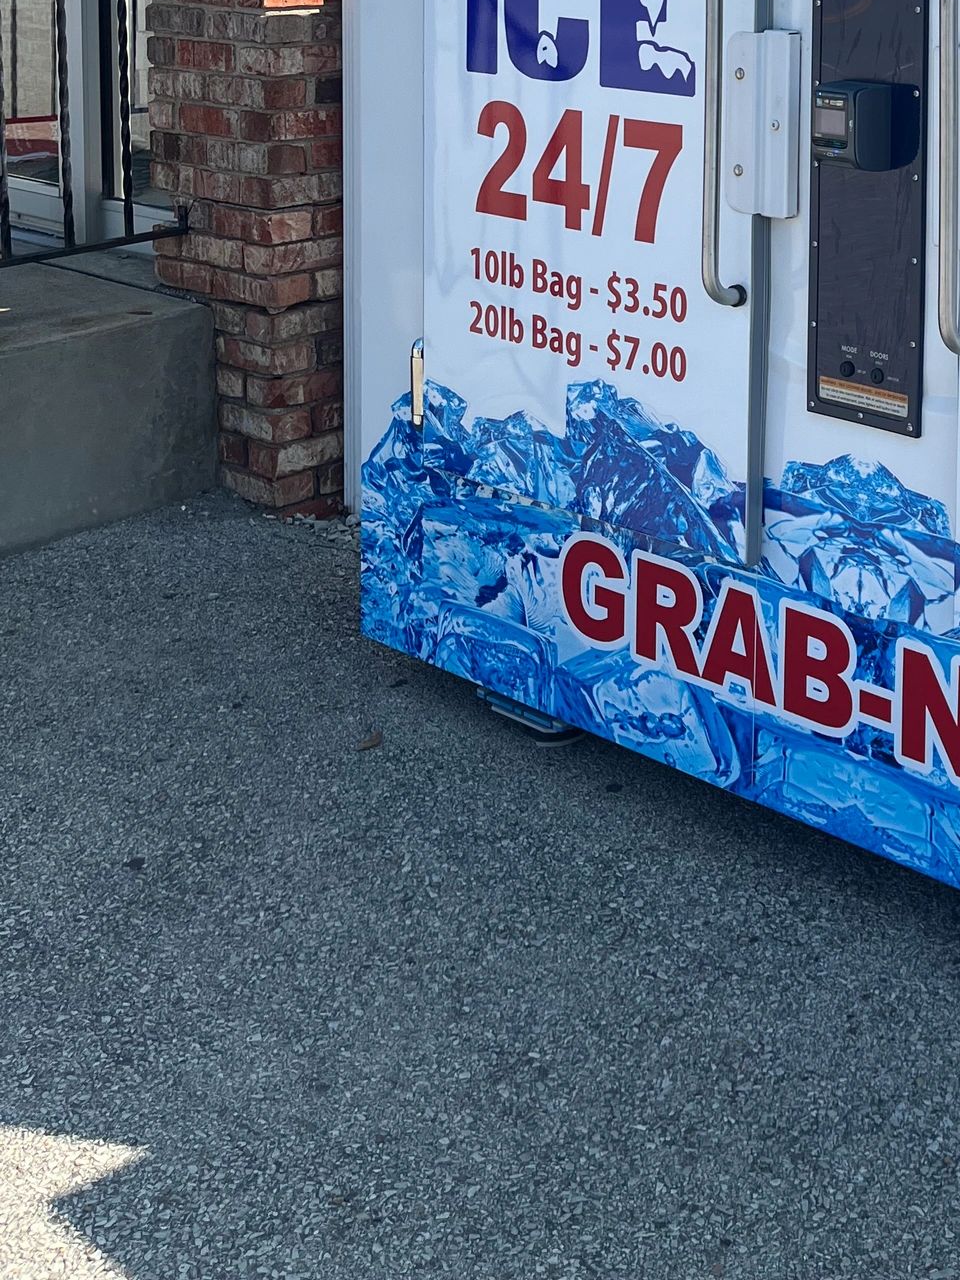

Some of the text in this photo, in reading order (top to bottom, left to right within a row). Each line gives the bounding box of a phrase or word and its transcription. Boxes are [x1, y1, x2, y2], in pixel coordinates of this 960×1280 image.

[475, 100, 683, 244] 24/7
[470, 247, 524, 289] 10lb
[532, 259, 582, 310] Bag
[607, 271, 687, 323] $3.50
[469, 301, 524, 344] 20lb
[532, 315, 581, 367] Bag
[606, 329, 687, 382] $7.00
[841, 345, 858, 354] MODE
[870, 351, 889, 360] DOORS
